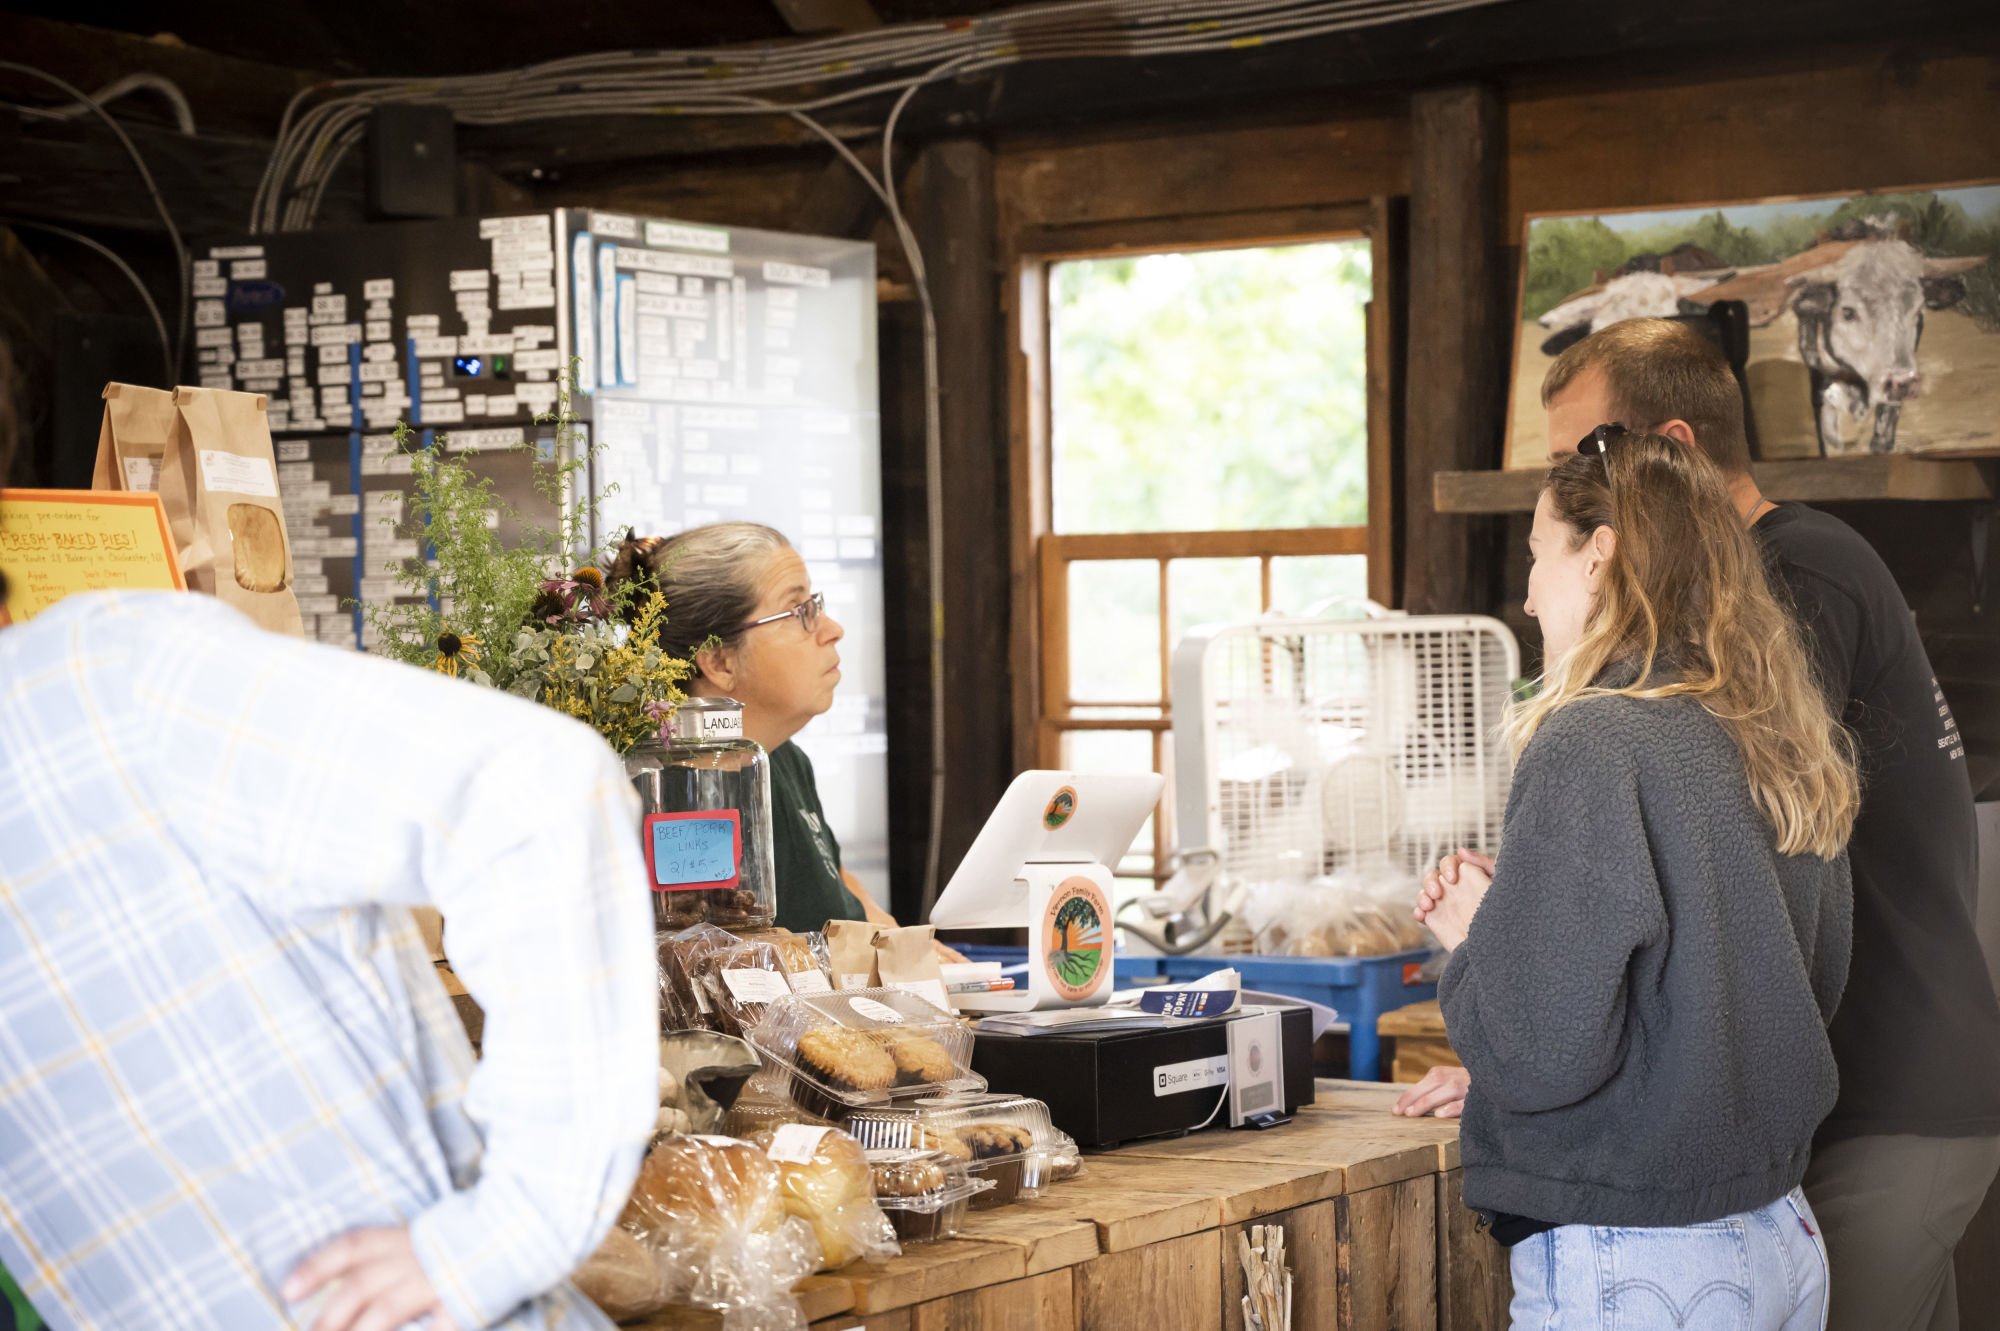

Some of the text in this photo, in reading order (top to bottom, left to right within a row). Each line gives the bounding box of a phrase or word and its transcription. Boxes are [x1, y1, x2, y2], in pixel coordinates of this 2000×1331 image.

[36, 511, 82, 525] pre-orders
[86, 508, 101, 521] for
[99, 529, 137, 548] PIES!
[27, 570, 48, 582] Apple
[678, 839, 709, 853] LINKS
[1050, 886, 1104, 916] Vernon Family Farm
[1161, 1002, 1174, 1016] TAP
[1171, 992, 1188, 1016] TO PAY
[1167, 1073, 1188, 1085] Square
